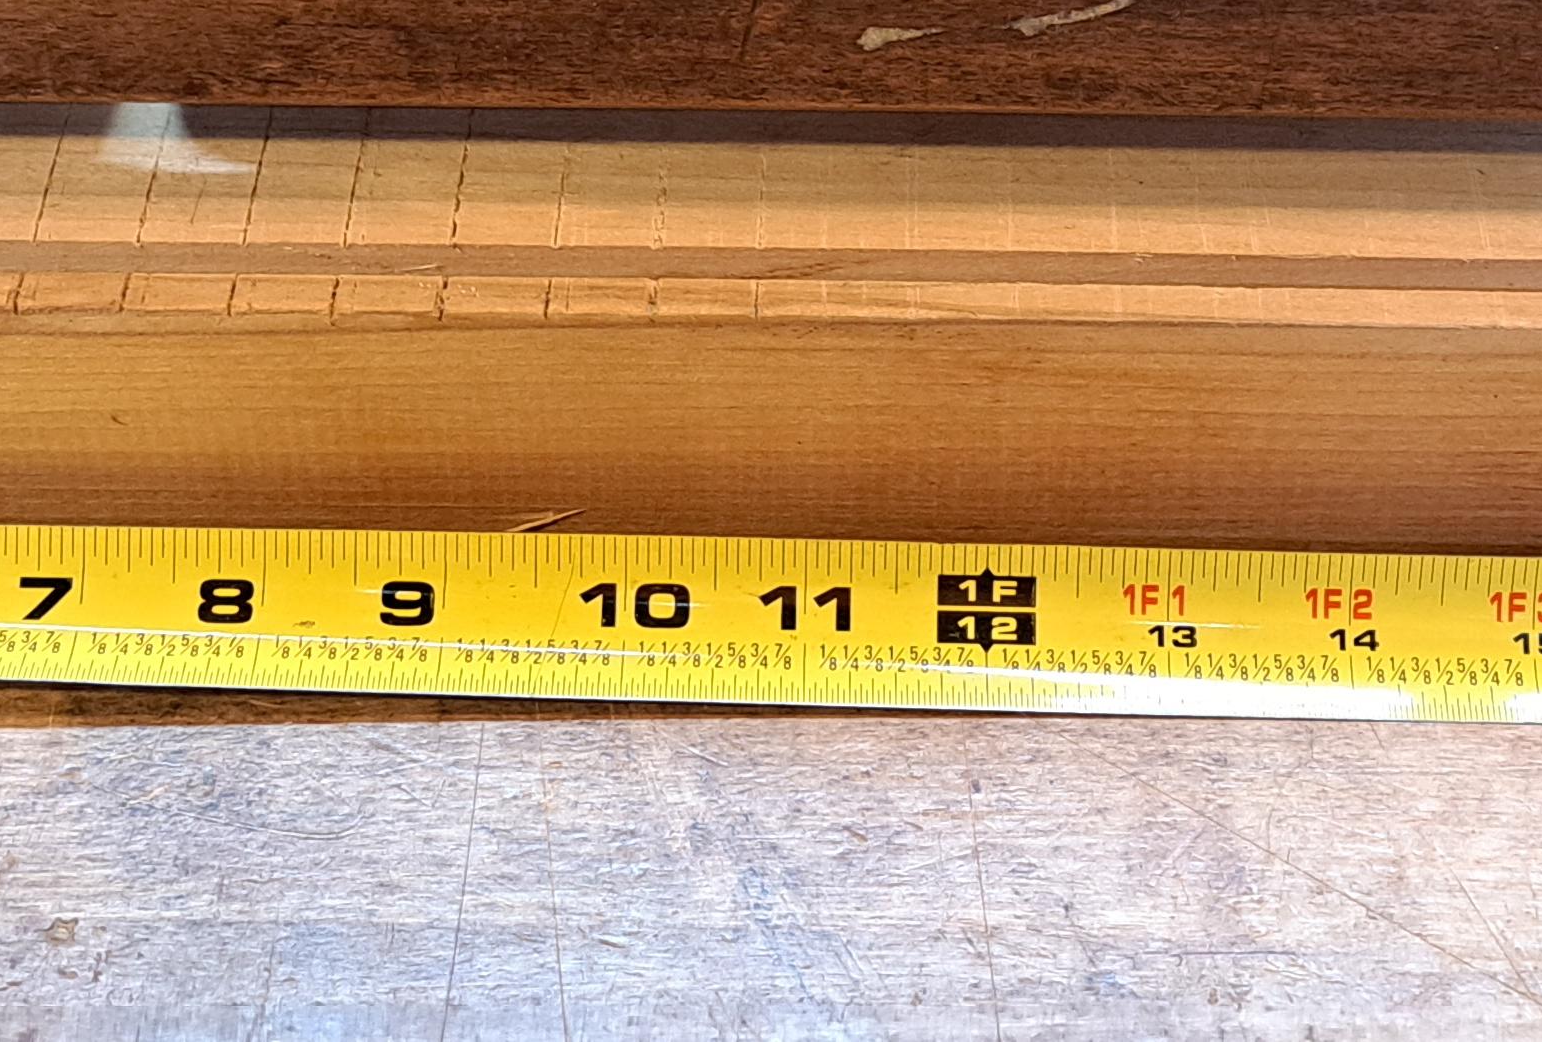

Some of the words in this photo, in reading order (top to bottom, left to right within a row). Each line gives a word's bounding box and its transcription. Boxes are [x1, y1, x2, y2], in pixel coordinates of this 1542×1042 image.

[19, 576, 73, 620] 7
[197, 578, 255, 624] 8
[379, 581, 436, 627] 9
[580, 583, 691, 629] 10
[759, 585, 852, 632] 11
[957, 579, 1020, 604] 1F
[957, 616, 1019, 640] 12
[1147, 625, 1198, 648] 13
[1329, 629, 1380, 652] 14
